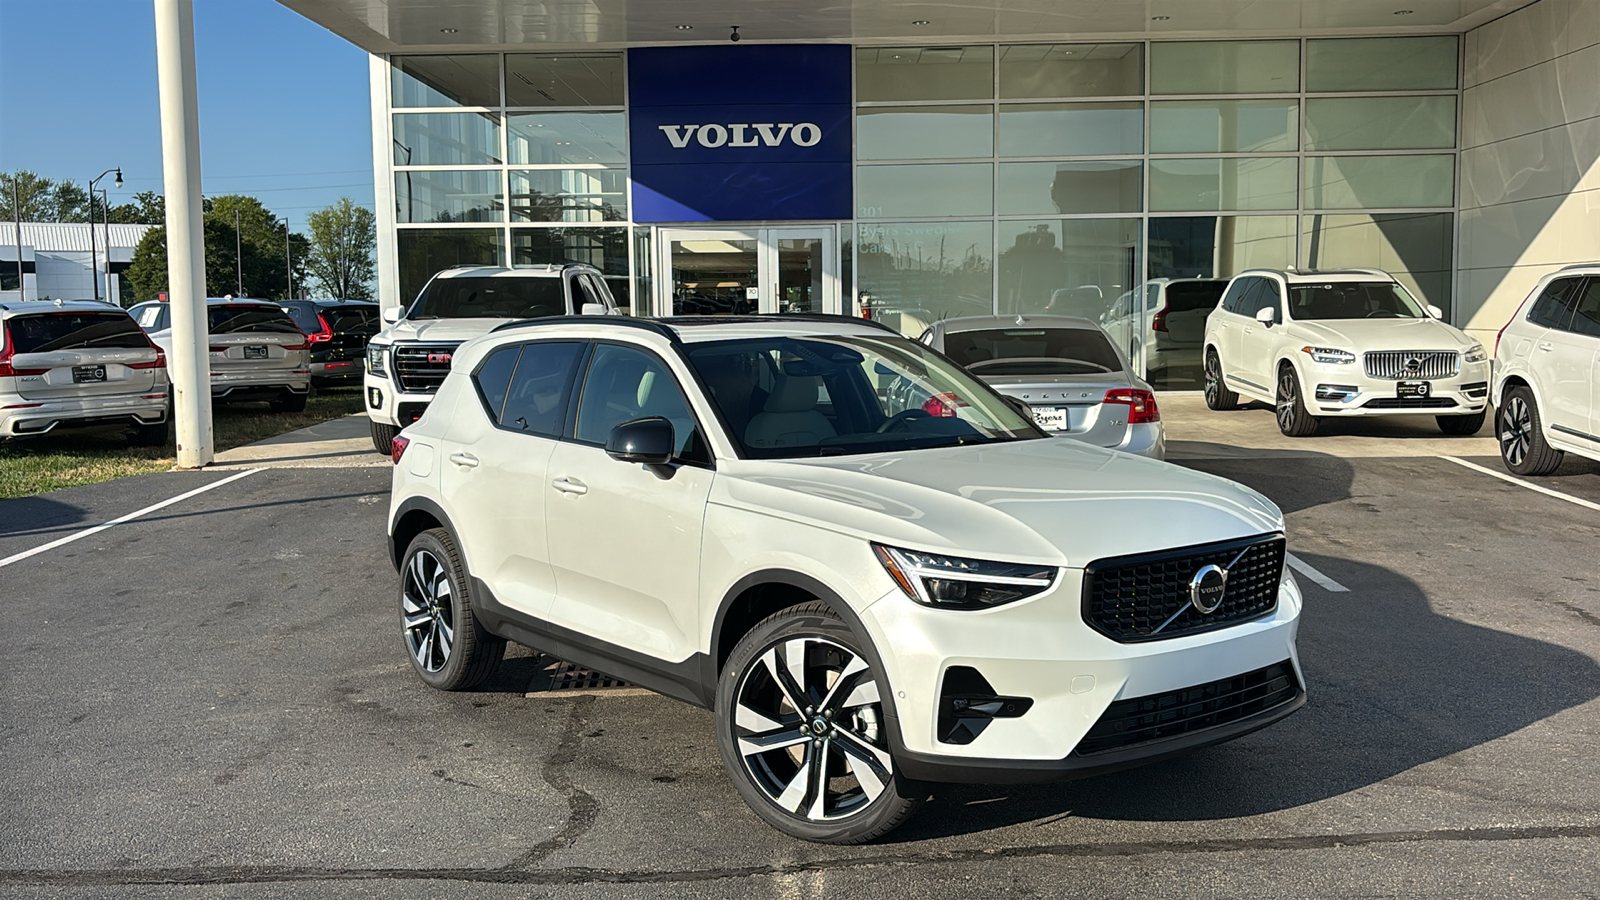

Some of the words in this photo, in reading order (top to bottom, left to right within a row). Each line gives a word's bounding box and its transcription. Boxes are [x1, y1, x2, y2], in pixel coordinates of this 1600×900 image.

[658, 122, 822, 148] VOLVO
[860, 206, 883, 217] 301
[859, 225, 899, 238] Byers
[428, 353, 452, 363] GM
[1032, 412, 1062, 424] Byers
[1200, 585, 1223, 594] VOLVO
